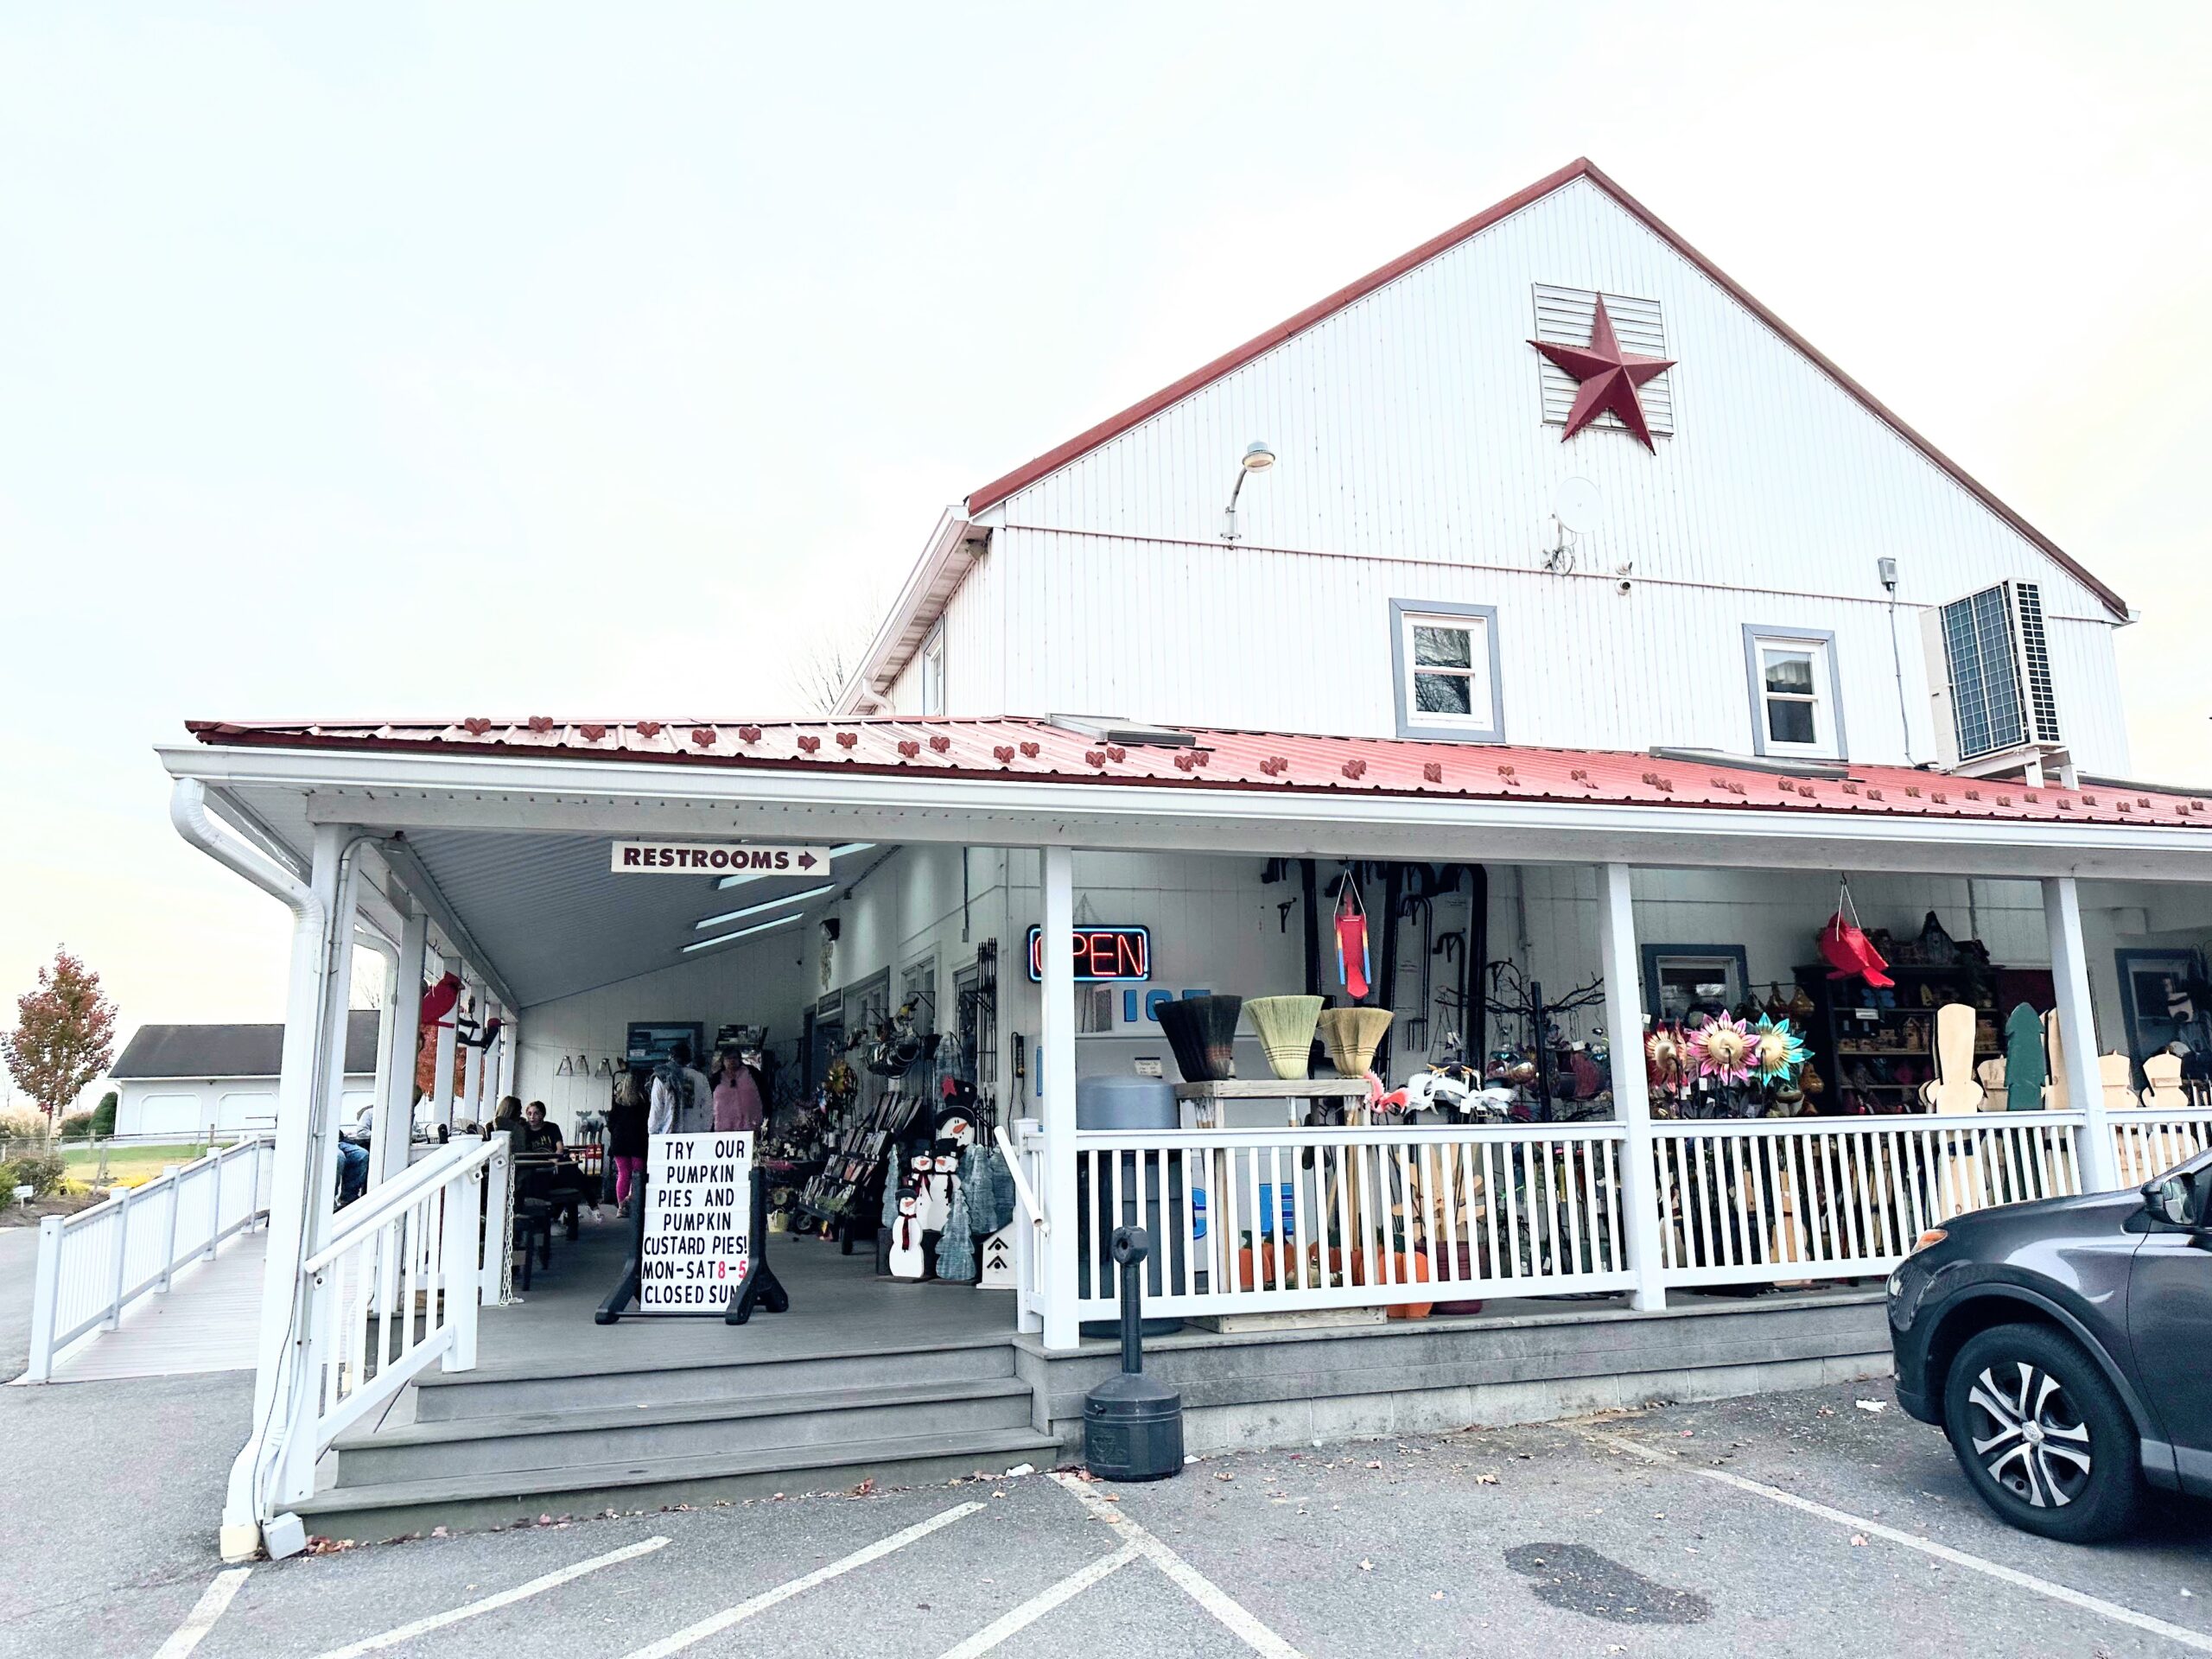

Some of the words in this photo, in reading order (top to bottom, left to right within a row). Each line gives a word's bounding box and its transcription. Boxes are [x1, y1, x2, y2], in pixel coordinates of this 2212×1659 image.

[623, 847, 790, 870] RESTROOMS
[665, 1141, 694, 1160] TRY
[715, 1140, 745, 1159] OUR
[667, 1165, 734, 1183] PUMPKIN
[658, 1190, 692, 1207] PIES
[705, 1188, 734, 1207] AND
[664, 1212, 731, 1231] PUMPKIN
[644, 1236, 705, 1255] CUSTARD
[713, 1236, 747, 1255] PIES!
[645, 1285, 703, 1303] CLOSED
